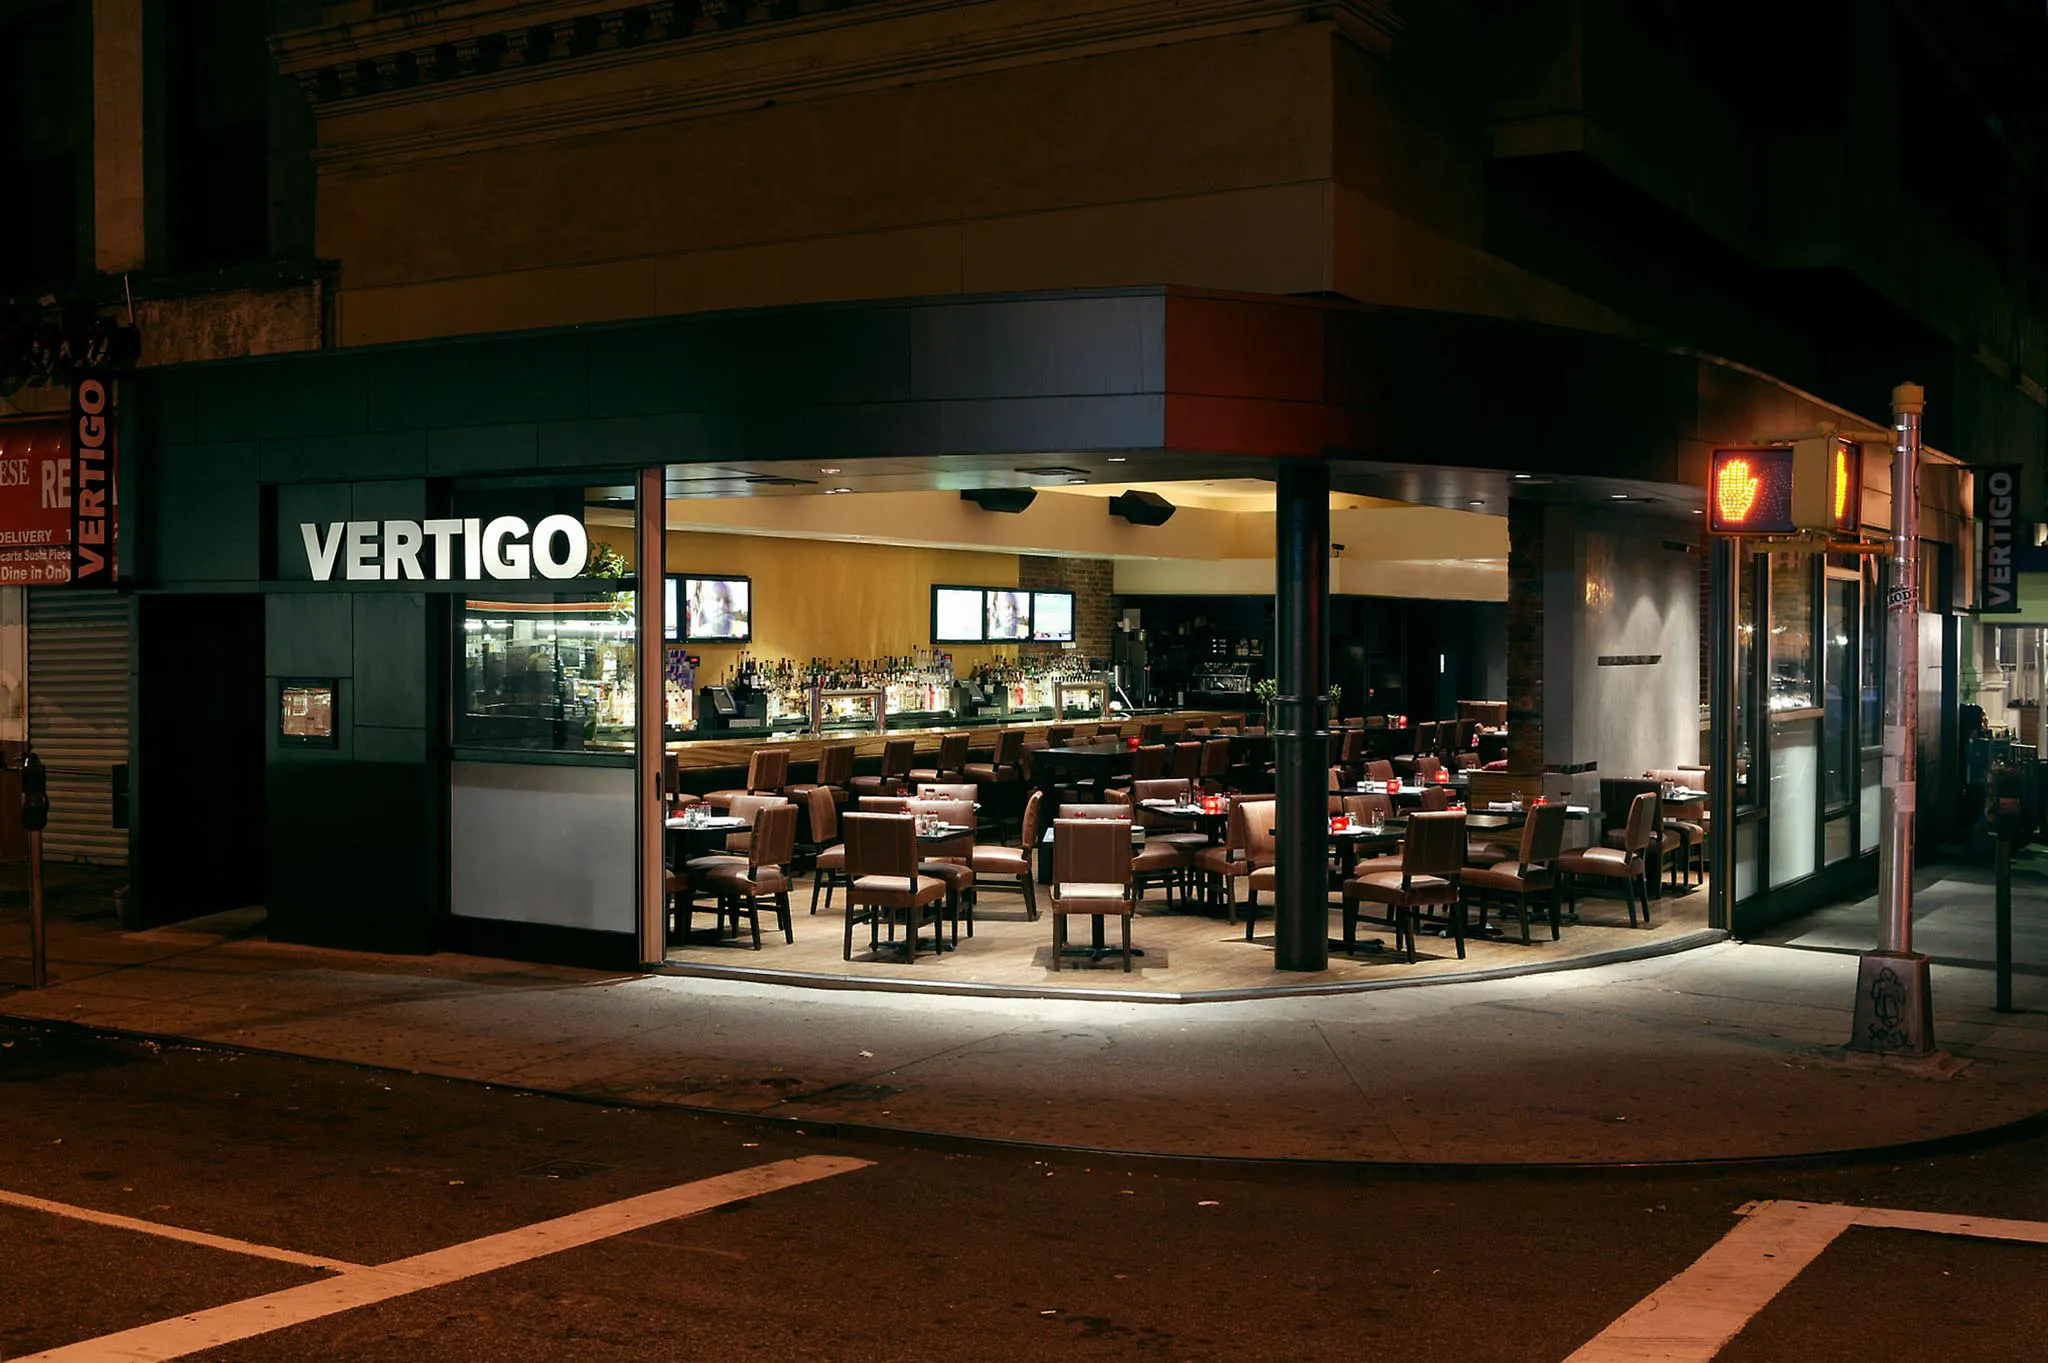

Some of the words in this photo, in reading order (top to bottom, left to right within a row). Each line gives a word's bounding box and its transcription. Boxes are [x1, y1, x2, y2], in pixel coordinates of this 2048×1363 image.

[78, 378, 106, 579] VERTIGO
[24, 549, 48, 561] Sushi
[300, 514, 588, 581] VERTIGO
[1988, 471, 2013, 608] VERTIGO
[1, 566, 28, 581] Dine
[31, 565, 42, 580] in
[45, 564, 72, 583] Only
